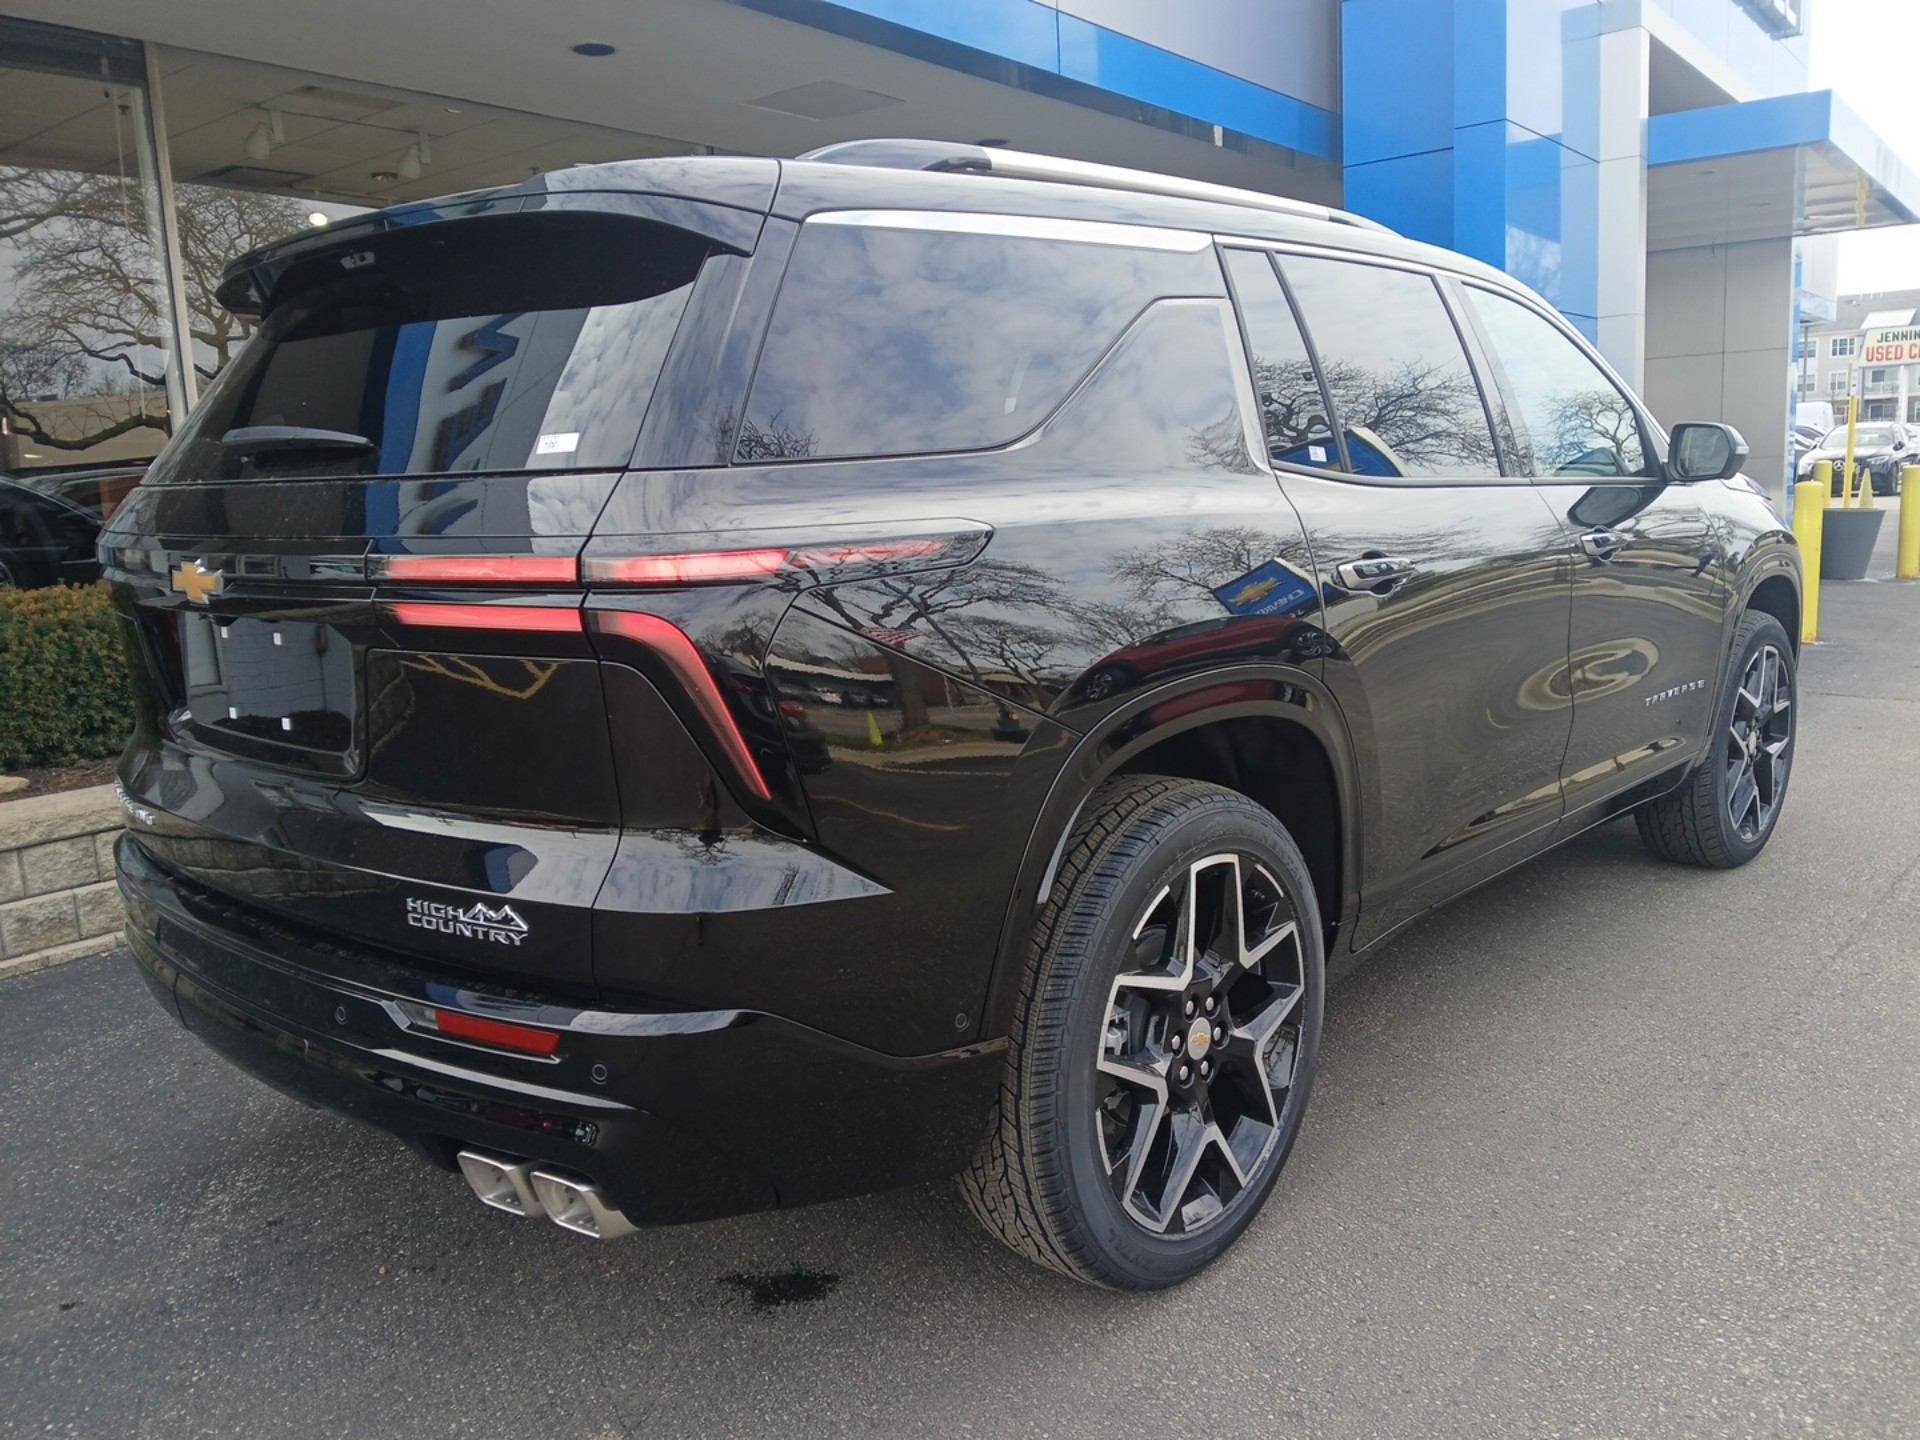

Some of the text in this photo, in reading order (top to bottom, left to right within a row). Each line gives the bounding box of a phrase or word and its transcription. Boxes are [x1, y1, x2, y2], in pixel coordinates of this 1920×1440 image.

[1876, 329, 1920, 343] JENNIN
[1866, 343, 1920, 362] USED C
[1645, 680, 1705, 706] TRAVERSE
[406, 897, 464, 922] HIGH
[407, 913, 528, 946] COUNTRY
